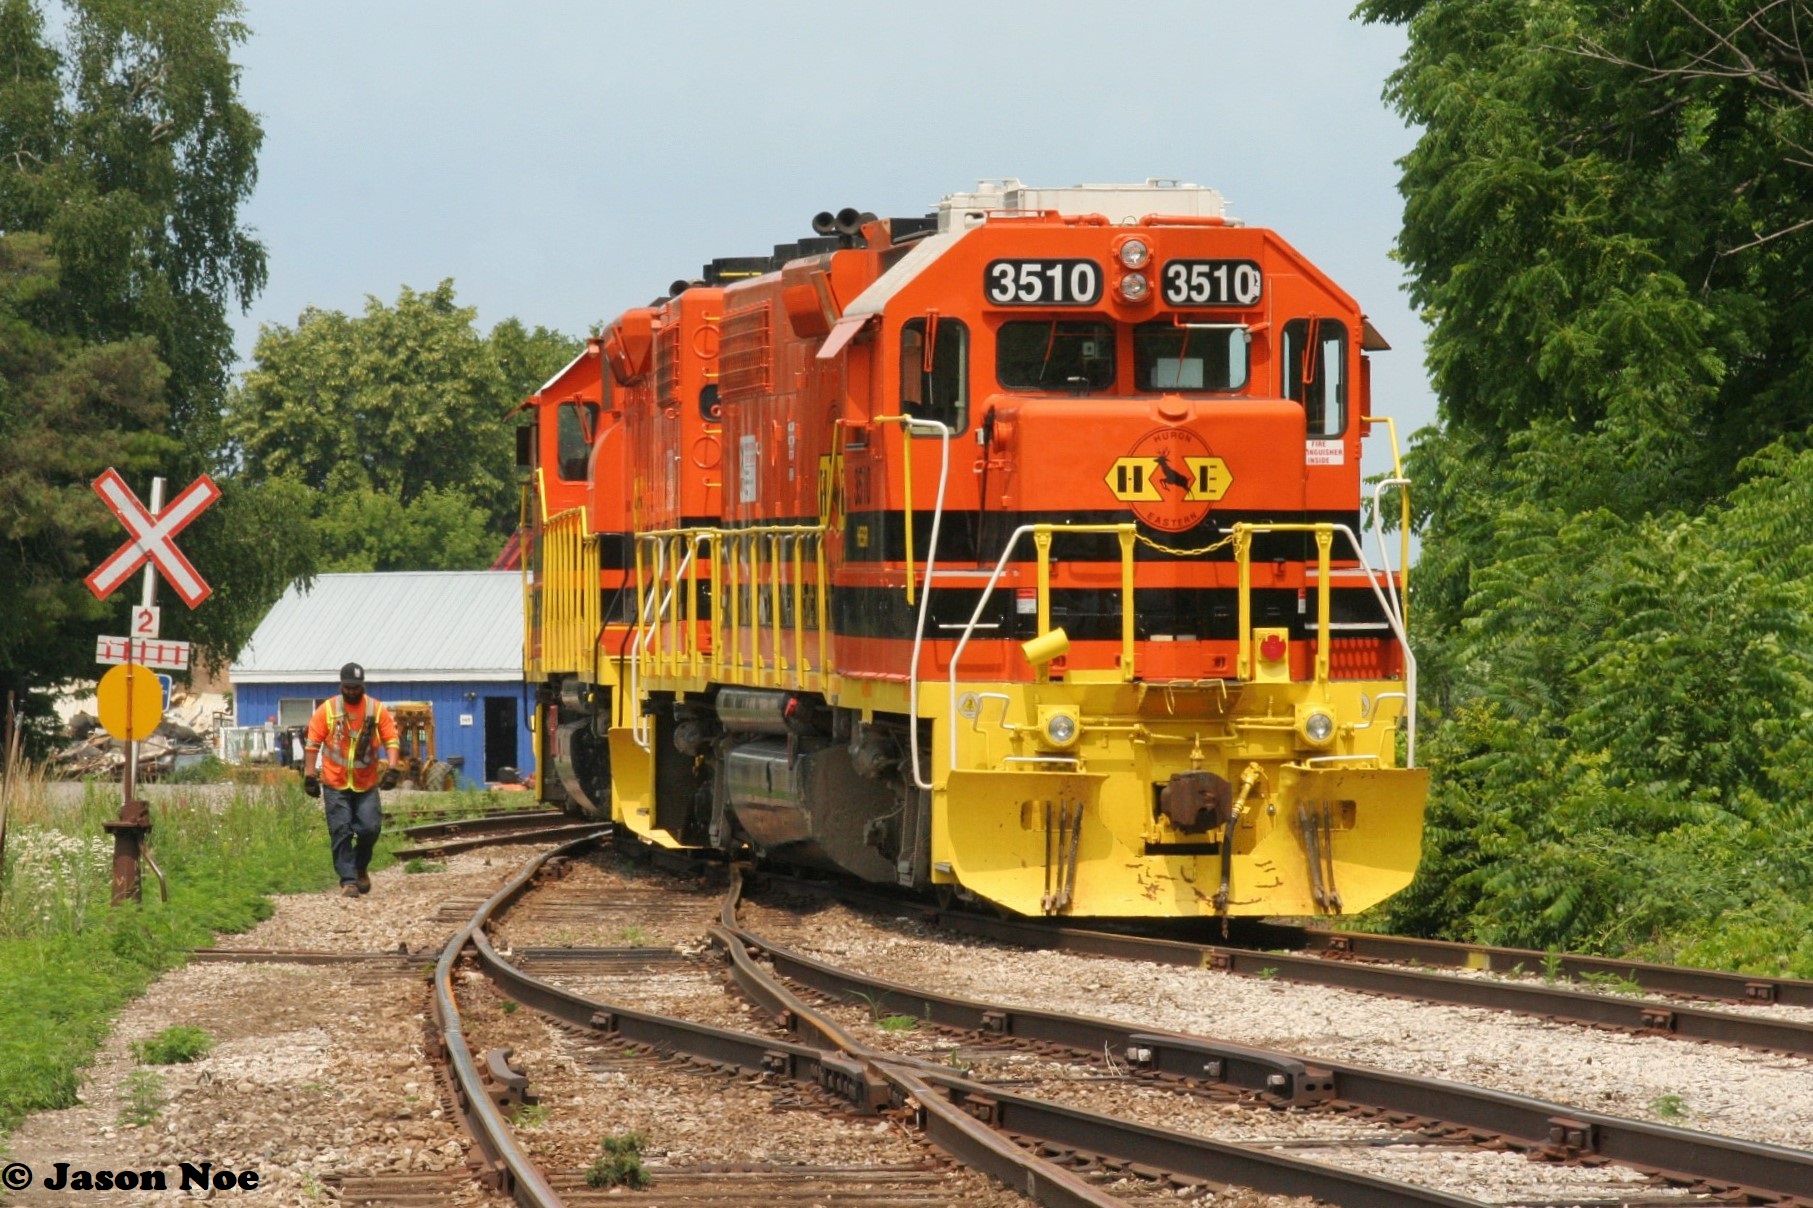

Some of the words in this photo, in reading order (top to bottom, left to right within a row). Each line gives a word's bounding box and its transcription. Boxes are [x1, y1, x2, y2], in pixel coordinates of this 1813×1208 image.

[991, 263, 1096, 302] 3510
[1167, 264, 1254, 303] 3510
[1153, 431, 1192, 443] HURON
[1311, 440, 1327, 448] FIRE
[1307, 448, 1343, 456] INGUISHER
[1307, 456, 1330, 464] INSIDE
[1117, 465, 1143, 493] H
[1199, 465, 1217, 493] E
[1146, 511, 1198, 527] EASTERN
[138, 609, 154, 633] 2
